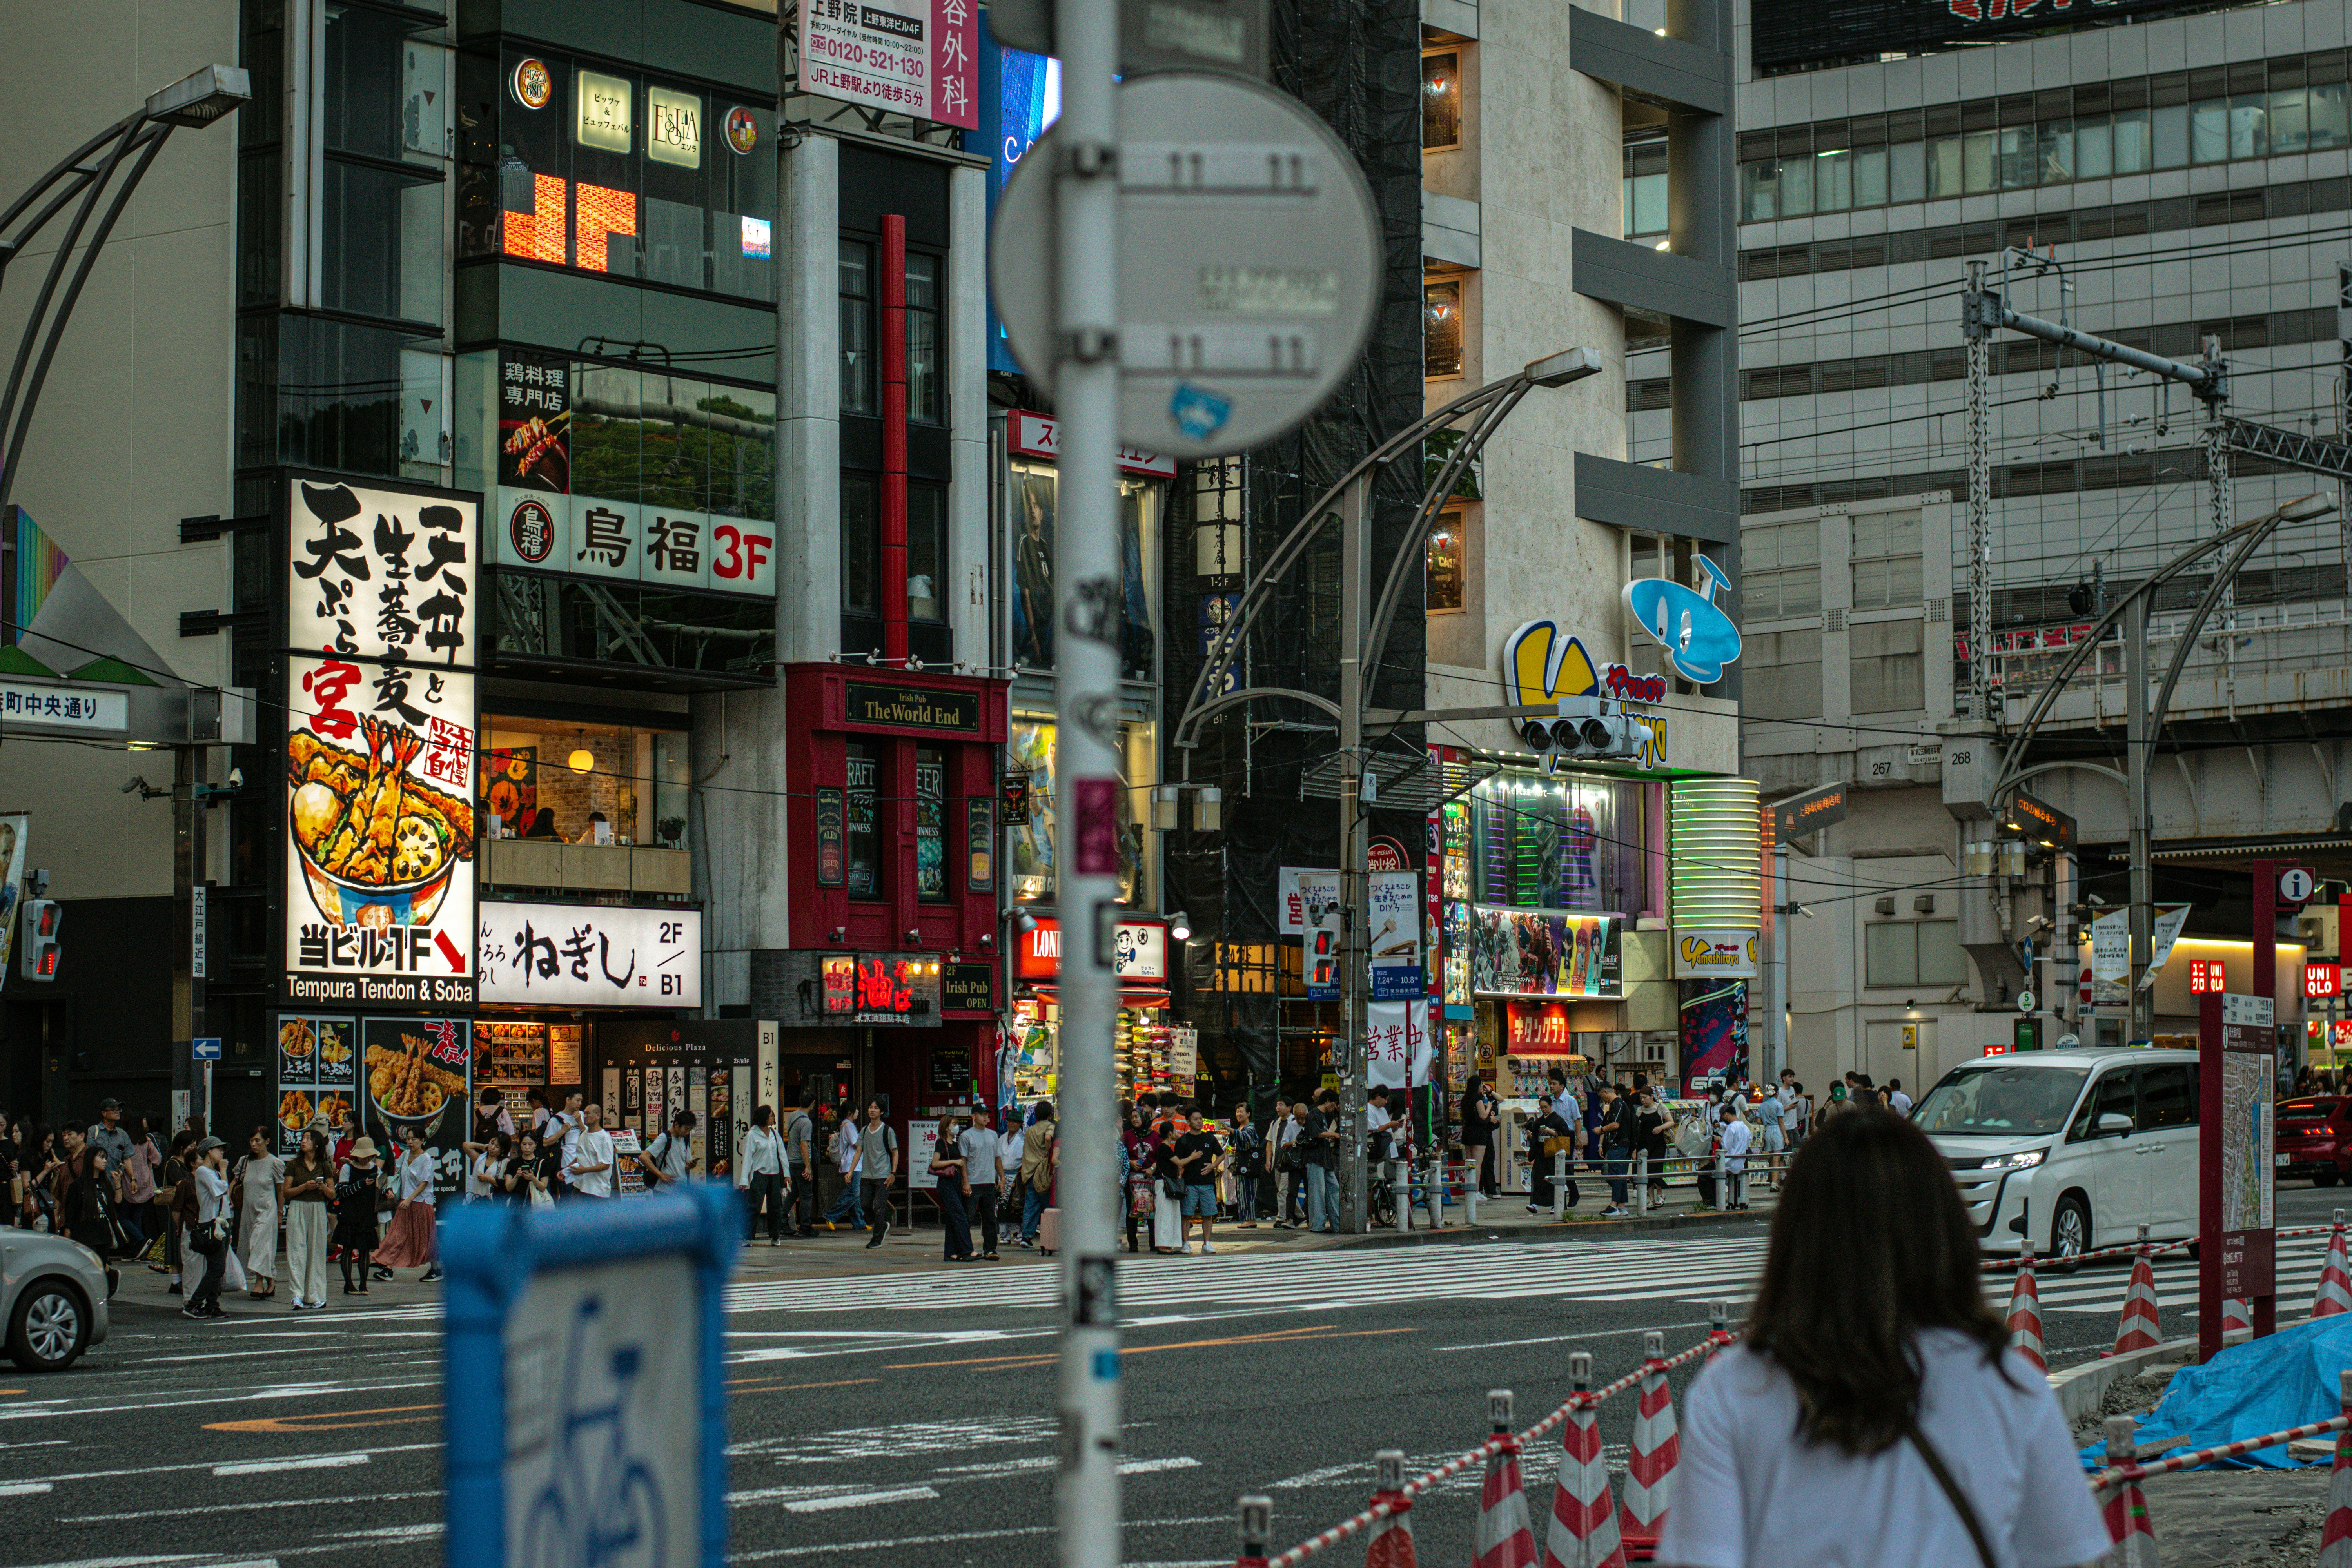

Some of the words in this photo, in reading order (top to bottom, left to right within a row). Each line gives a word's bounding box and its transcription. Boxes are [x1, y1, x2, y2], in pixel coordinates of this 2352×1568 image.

[811, 0, 858, 25] 上野院
[863, 11, 920, 35] 上野東洋ビル4F
[810, 20, 858, 38] 予約フリーダイヤル
[810, 47, 826, 56] 携帯OK
[828, 38, 924, 78] 0120-521-130
[524, 68, 548, 84] PIZZA
[526, 82, 542, 98] 680
[811, 68, 924, 107] JR上野駅より徒歩5分
[594, 93, 620, 106] ピッツァ
[604, 107, 611, 116] &
[583, 116, 630, 134] ビュッフェバル
[729, 129, 737, 145] FREE
[738, 140, 748, 150] WINE
[681, 143, 697, 152] エソラ
[504, 362, 564, 389] 鶏料理
[504, 385, 563, 412] 専門店
[577, 507, 700, 574] 鳥福
[713, 525, 772, 581] 3F
[292, 479, 371, 655] 天ぷら
[414, 505, 467, 704] 天丼と
[372, 513, 432, 727] 生蕎麦
[899, 692, 913, 702] Irish
[914, 694, 926, 703] Pub
[0, 691, 96, 720] 町中央通り
[865, 701, 891, 720] The
[892, 704, 931, 724] World
[935, 707, 960, 725] End
[1951, 751, 1971, 765] 268
[1873, 762, 1891, 775] 267
[1798, 793, 1841, 817] 上野駅前商店街
[823, 831, 838, 840] ALES
[823, 860, 838, 869] BEER
[1371, 884, 1411, 894] つくるよろこび
[1374, 894, 1412, 902] 生きるための
[1379, 904, 1392, 912] DIY
[195, 891, 204, 974] 大江戸線近道
[659, 922, 682, 944] 2F
[299, 924, 431, 972] 当ビル1F
[512, 919, 635, 989] ねぎし
[1681, 936, 1739, 969] Yamashiroya
[1607, 954, 1618, 962] mini
[947, 966, 956, 976] 2F
[2192, 964, 2205, 976] ユニ
[2210, 964, 2222, 978] UNI
[2307, 967, 2330, 980] UNI
[287, 975, 354, 1002] Tempura
[360, 978, 415, 1000] Tendon
[419, 980, 431, 1000] &
[435, 980, 472, 1002] Soba
[661, 974, 681, 995] B1
[858, 959, 894, 1009] 油
[946, 981, 968, 993] Irish
[970, 981, 988, 994] Pub
[2192, 978, 2205, 991] クロ
[2210, 978, 2223, 991] QLO
[2307, 981, 2332, 995] QLO
[967, 998, 987, 1008] OPEN
[2024, 993, 2029, 1002] 5
[855, 1013, 911, 1024] 東京油組総本店
[424, 1019, 458, 1042] 一番
[559, 1027, 580, 1042] 急募
[763, 1032, 774, 1045] B1
[645, 1044, 682, 1052] Delicious
[283, 1060, 312, 1074] 上天丼
[764, 1060, 773, 1098] 牛たん
[922, 1129, 937, 1142] 油
